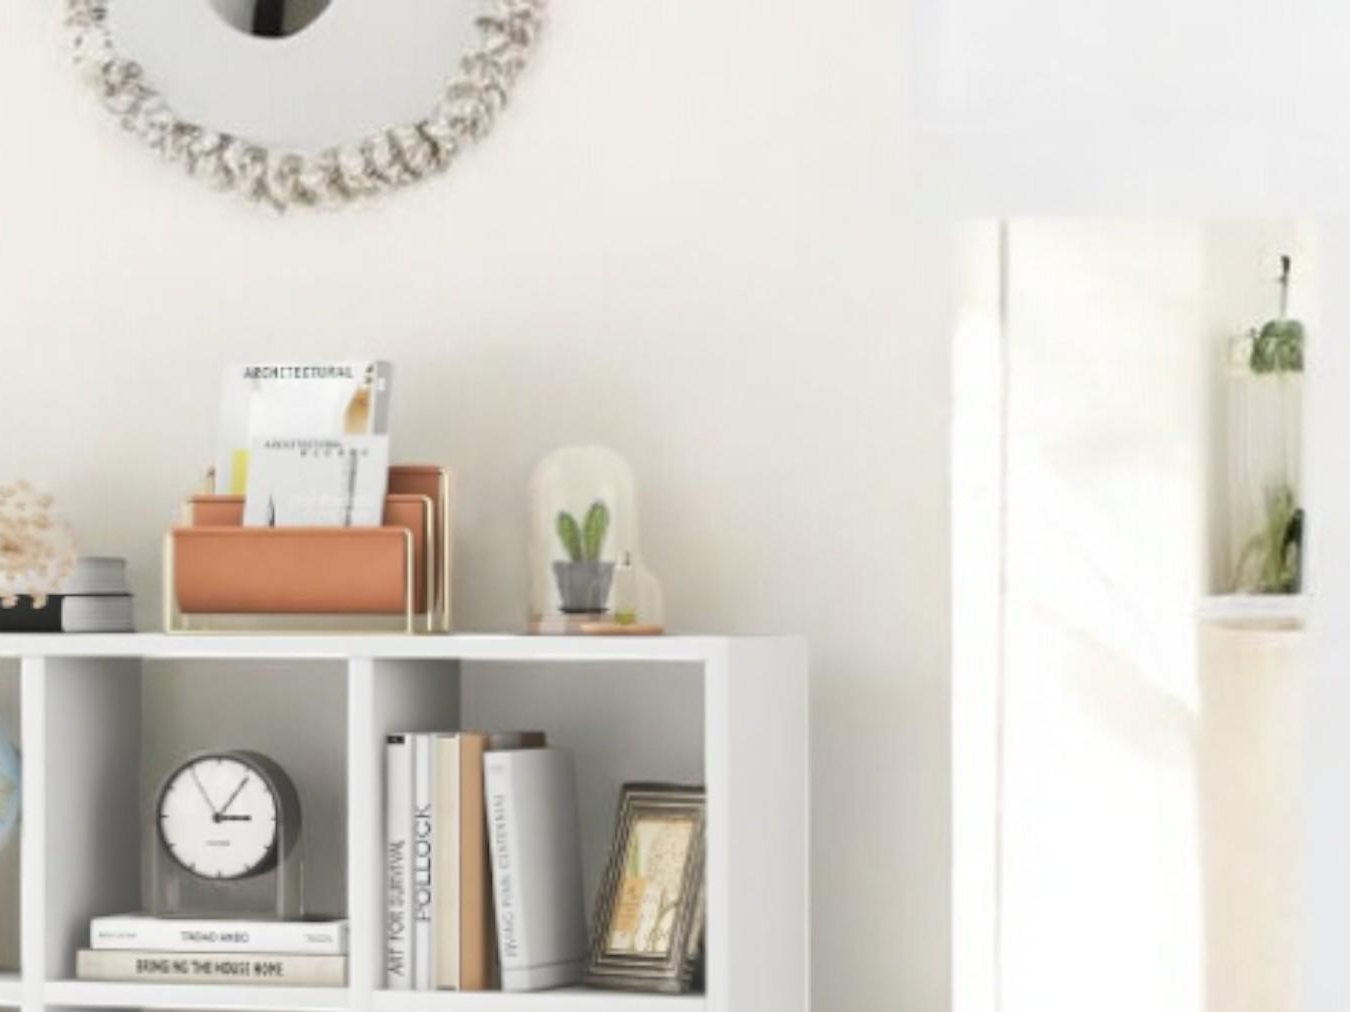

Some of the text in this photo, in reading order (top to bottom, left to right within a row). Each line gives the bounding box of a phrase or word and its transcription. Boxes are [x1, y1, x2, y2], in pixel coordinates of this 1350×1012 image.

[243, 366, 353, 379] ARCHITECTURAL
[416, 803, 432, 923] POLLOCK
[191, 960, 213, 975] THE
[215, 961, 251, 975] HOUSE
